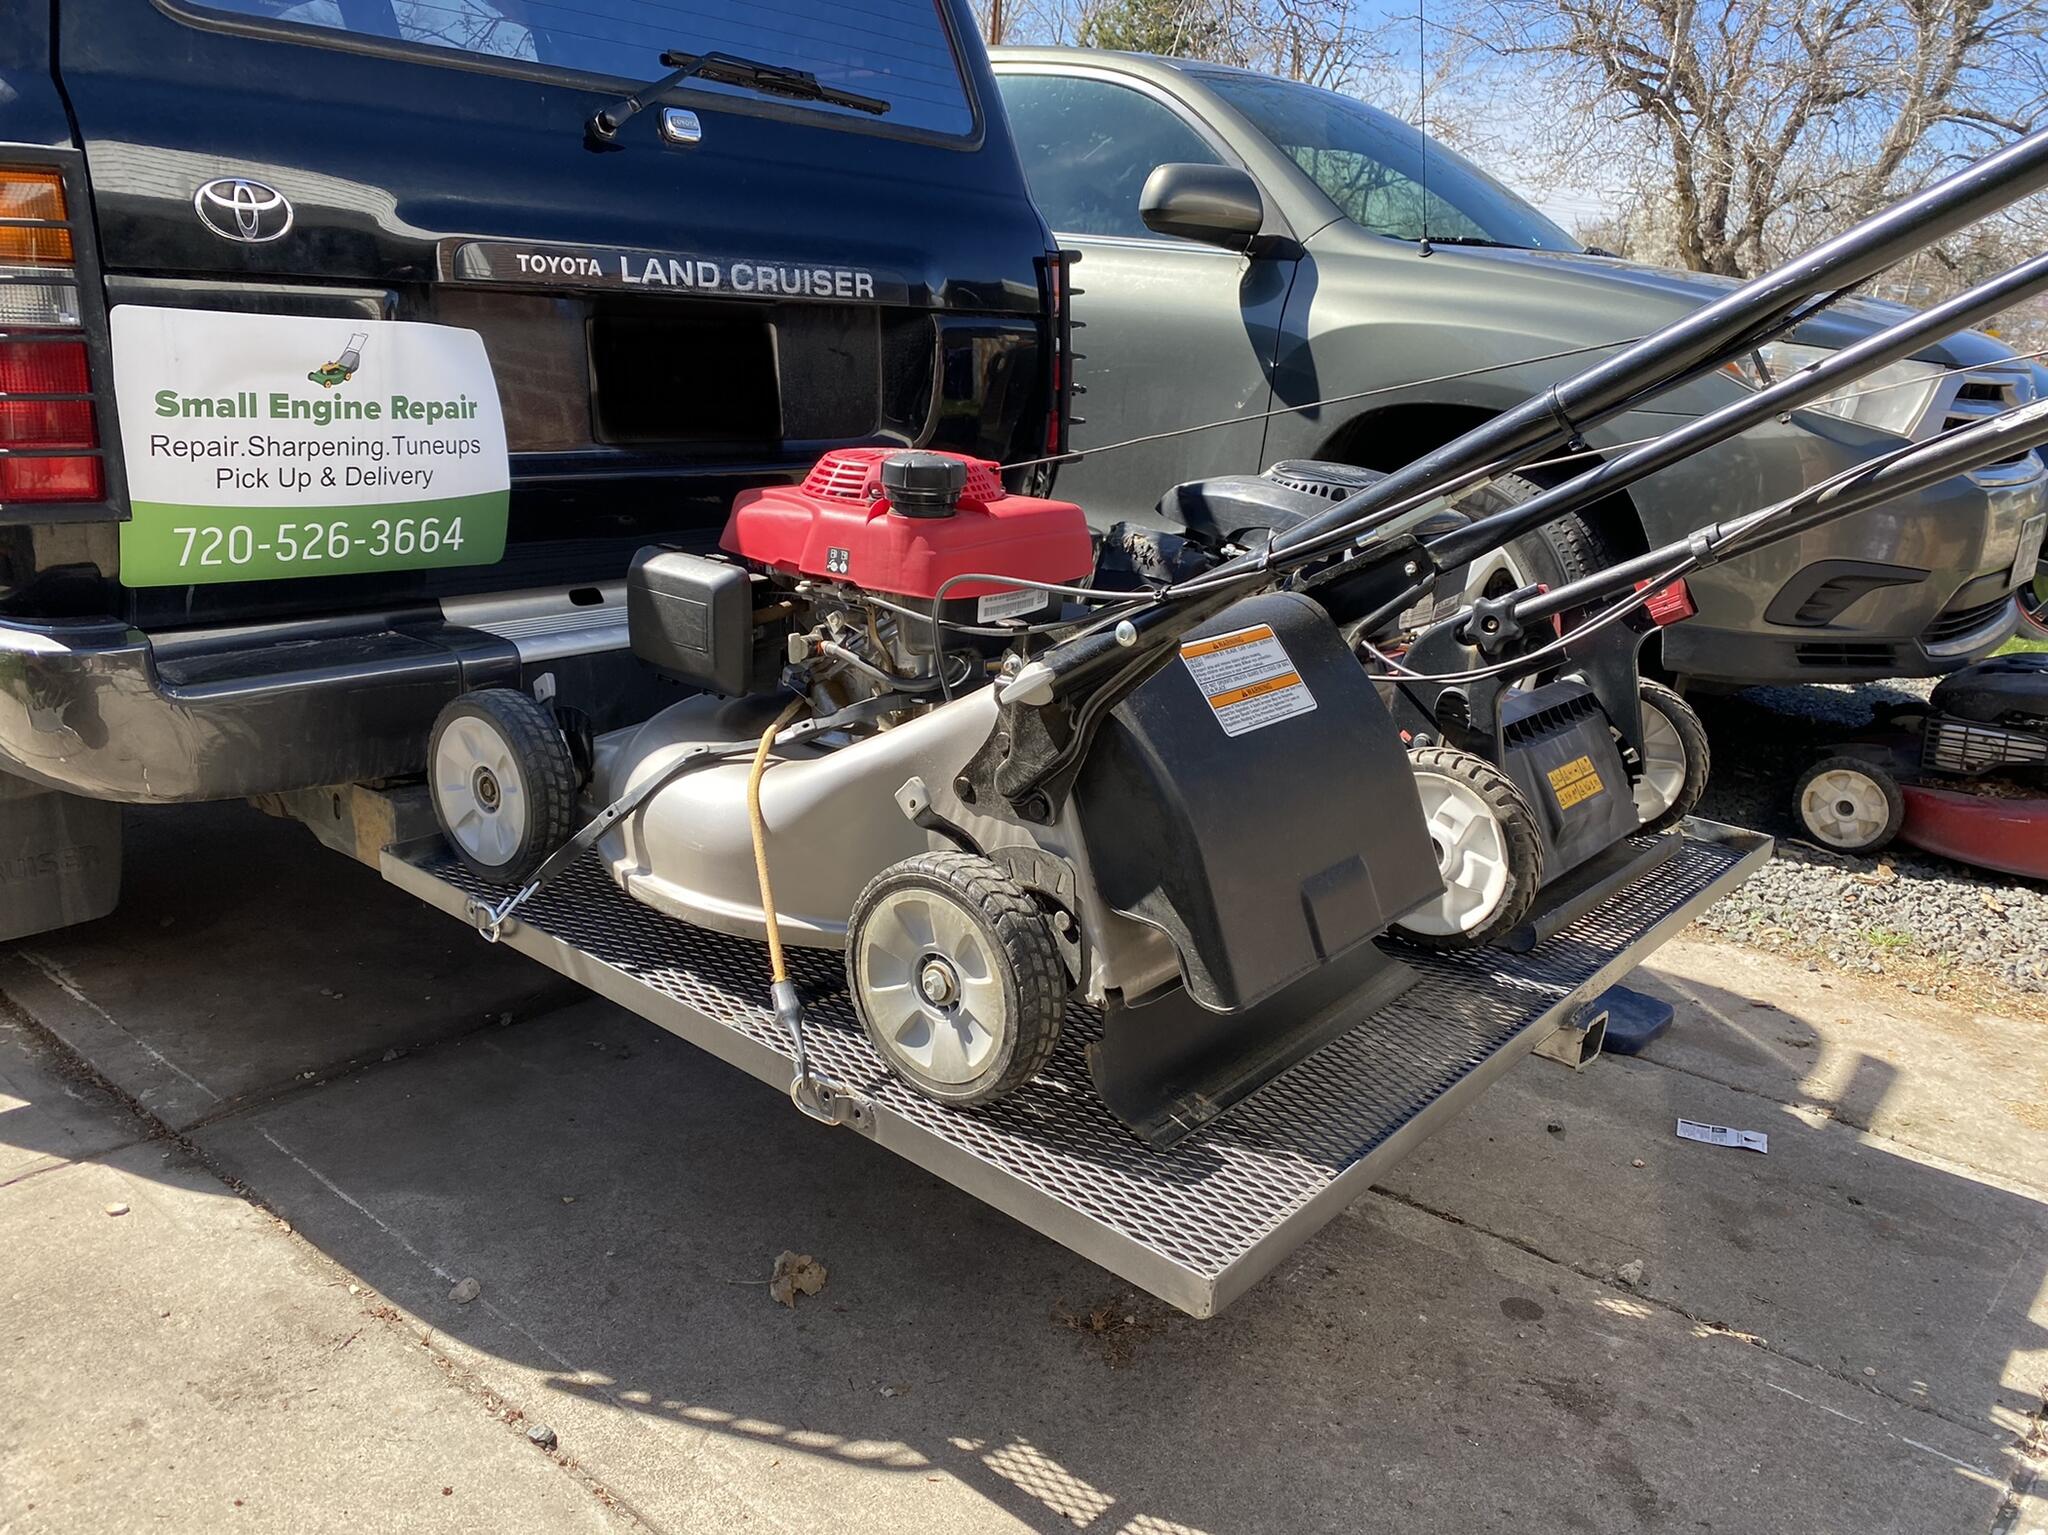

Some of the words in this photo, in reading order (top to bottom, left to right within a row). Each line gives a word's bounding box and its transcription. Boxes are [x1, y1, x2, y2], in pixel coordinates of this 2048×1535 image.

[516, 254, 602, 277] TOYOTA
[619, 256, 720, 289] LAND
[731, 263, 874, 298] CRUISER
[155, 390, 257, 419] Small
[269, 393, 382, 425] Engine
[391, 394, 477, 424] Repair
[216, 467, 269, 489] Pick
[278, 467, 312, 491] Up
[320, 468, 336, 487] &
[346, 467, 433, 489] Delivery
[173, 516, 464, 567] 720-526-3664
